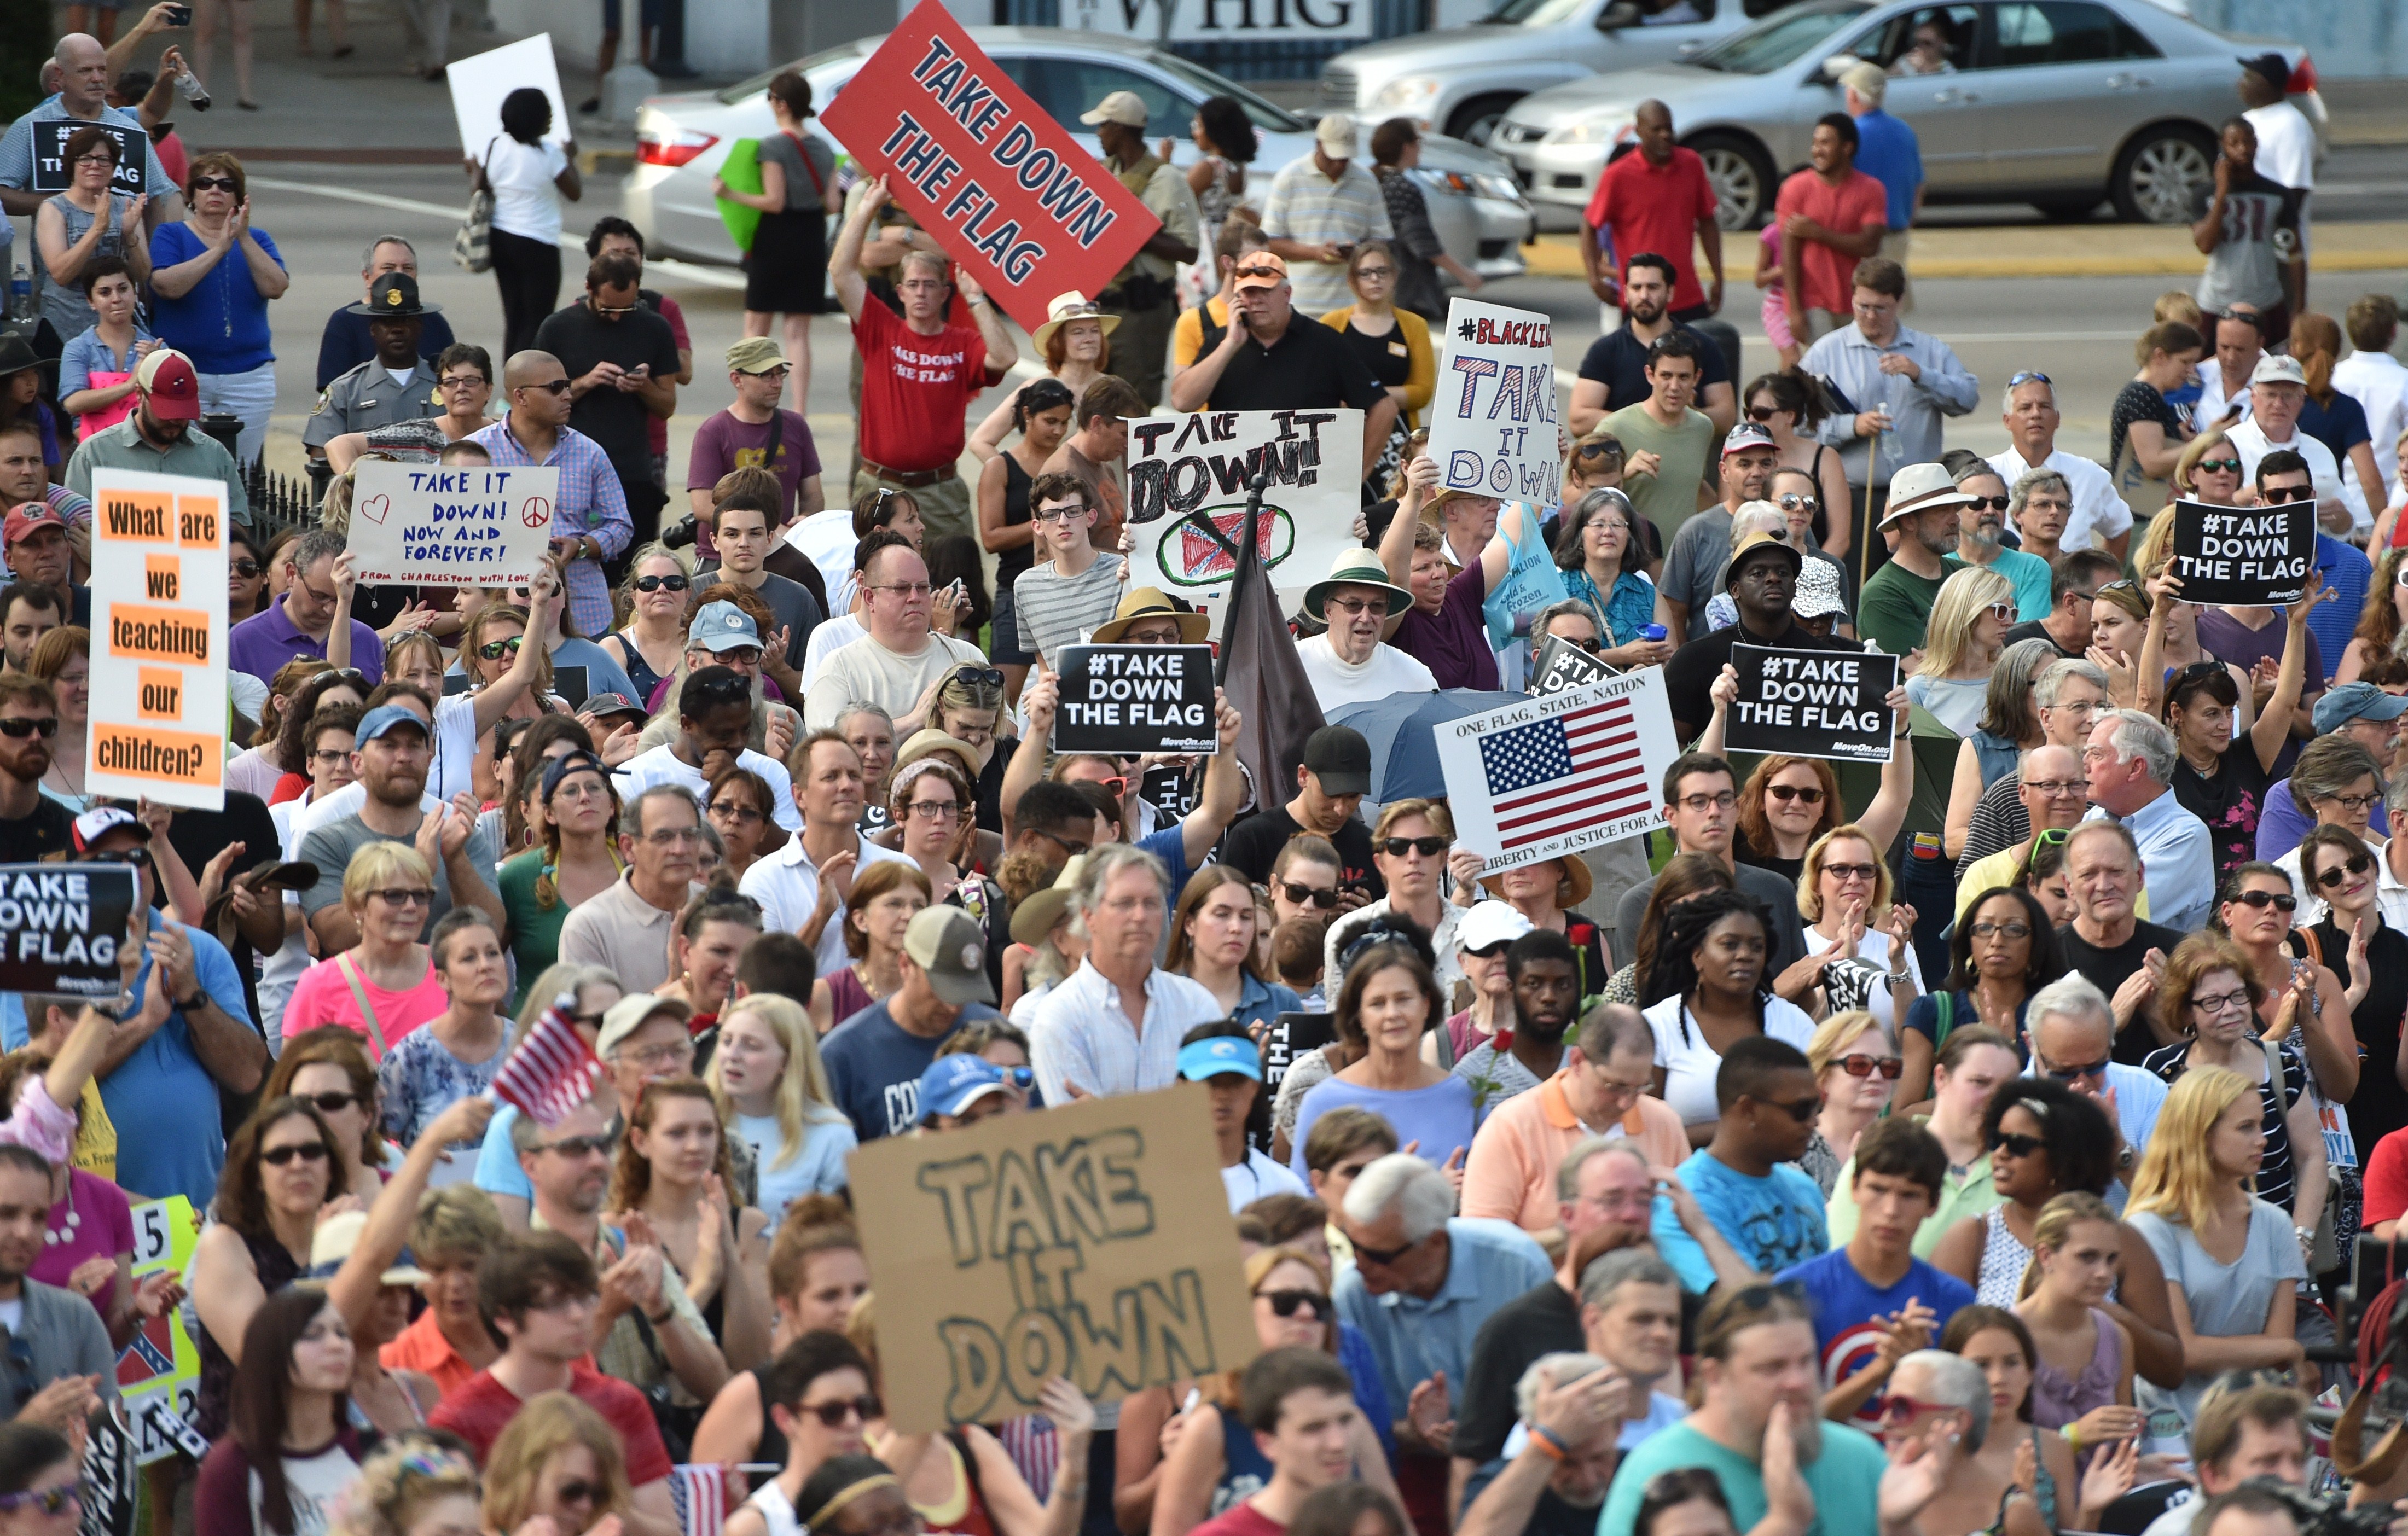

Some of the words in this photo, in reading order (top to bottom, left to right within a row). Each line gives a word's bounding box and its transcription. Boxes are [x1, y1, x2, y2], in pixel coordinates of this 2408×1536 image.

[910, 34, 1010, 144] TAKE
[990, 121, 1118, 249] DOWN
[879, 110, 963, 203] THE
[942, 179, 1047, 287] FLAG
[919, 351, 964, 366] DOWN
[1452, 354, 1556, 424] TAKE
[1134, 412, 1239, 458] TAKE
[1271, 410, 1337, 442] IT
[1498, 427, 1529, 457] IT
[409, 472, 470, 493] TAKE
[485, 472, 511, 494] IT
[1446, 450, 1560, 506] DOWN
[108, 501, 164, 537] What
[181, 512, 215, 541] are
[433, 501, 507, 522] DOWN!
[2202, 513, 2288, 536] #TAKE
[403, 526, 445, 542] NOW
[454, 525, 501, 540] AND
[2201, 536, 2288, 558] DOWN
[404, 544, 507, 563] FOREVER!
[2179, 555, 2231, 580] THE
[2240, 557, 2305, 580] FLAG
[147, 571, 177, 600] we
[359, 571, 392, 580] FROM
[401, 572, 472, 583] CHARLESTON
[479, 574, 504, 583] WITH
[507, 574, 530, 583] LOVE
[1507, 589, 1542, 612] Frozen
[113, 616, 208, 660] teaching
[1088, 654, 1183, 677] #TAKE
[1761, 656, 1860, 683] #TAKE
[142, 683, 178, 714] our
[1088, 678, 1183, 701] DOWN
[1761, 679, 1859, 707] DOWN
[1064, 703, 1121, 725] THE
[1129, 703, 1204, 726] FLAG
[1456, 720, 1486, 738] ONE
[1492, 708, 1534, 729] FLAG,
[1539, 693, 1587, 715] STATE,
[1593, 676, 1646, 701] NATION
[1736, 701, 1794, 726] THE
[1802, 706, 1880, 732] FLAG
[98, 736, 203, 777] children?
[1159, 776, 1178, 814] TH
[1483, 847, 1537, 871] LIBERTY
[1542, 842, 1559, 853] AND
[1563, 824, 1617, 850] JUSTICE
[1620, 816, 1649, 834] FOR
[18, 931, 116, 968] FLAG
[918, 1125, 1155, 1269] TAKE
[1008, 1239, 1085, 1313] IT
[938, 1269, 1217, 1426] DOWN
